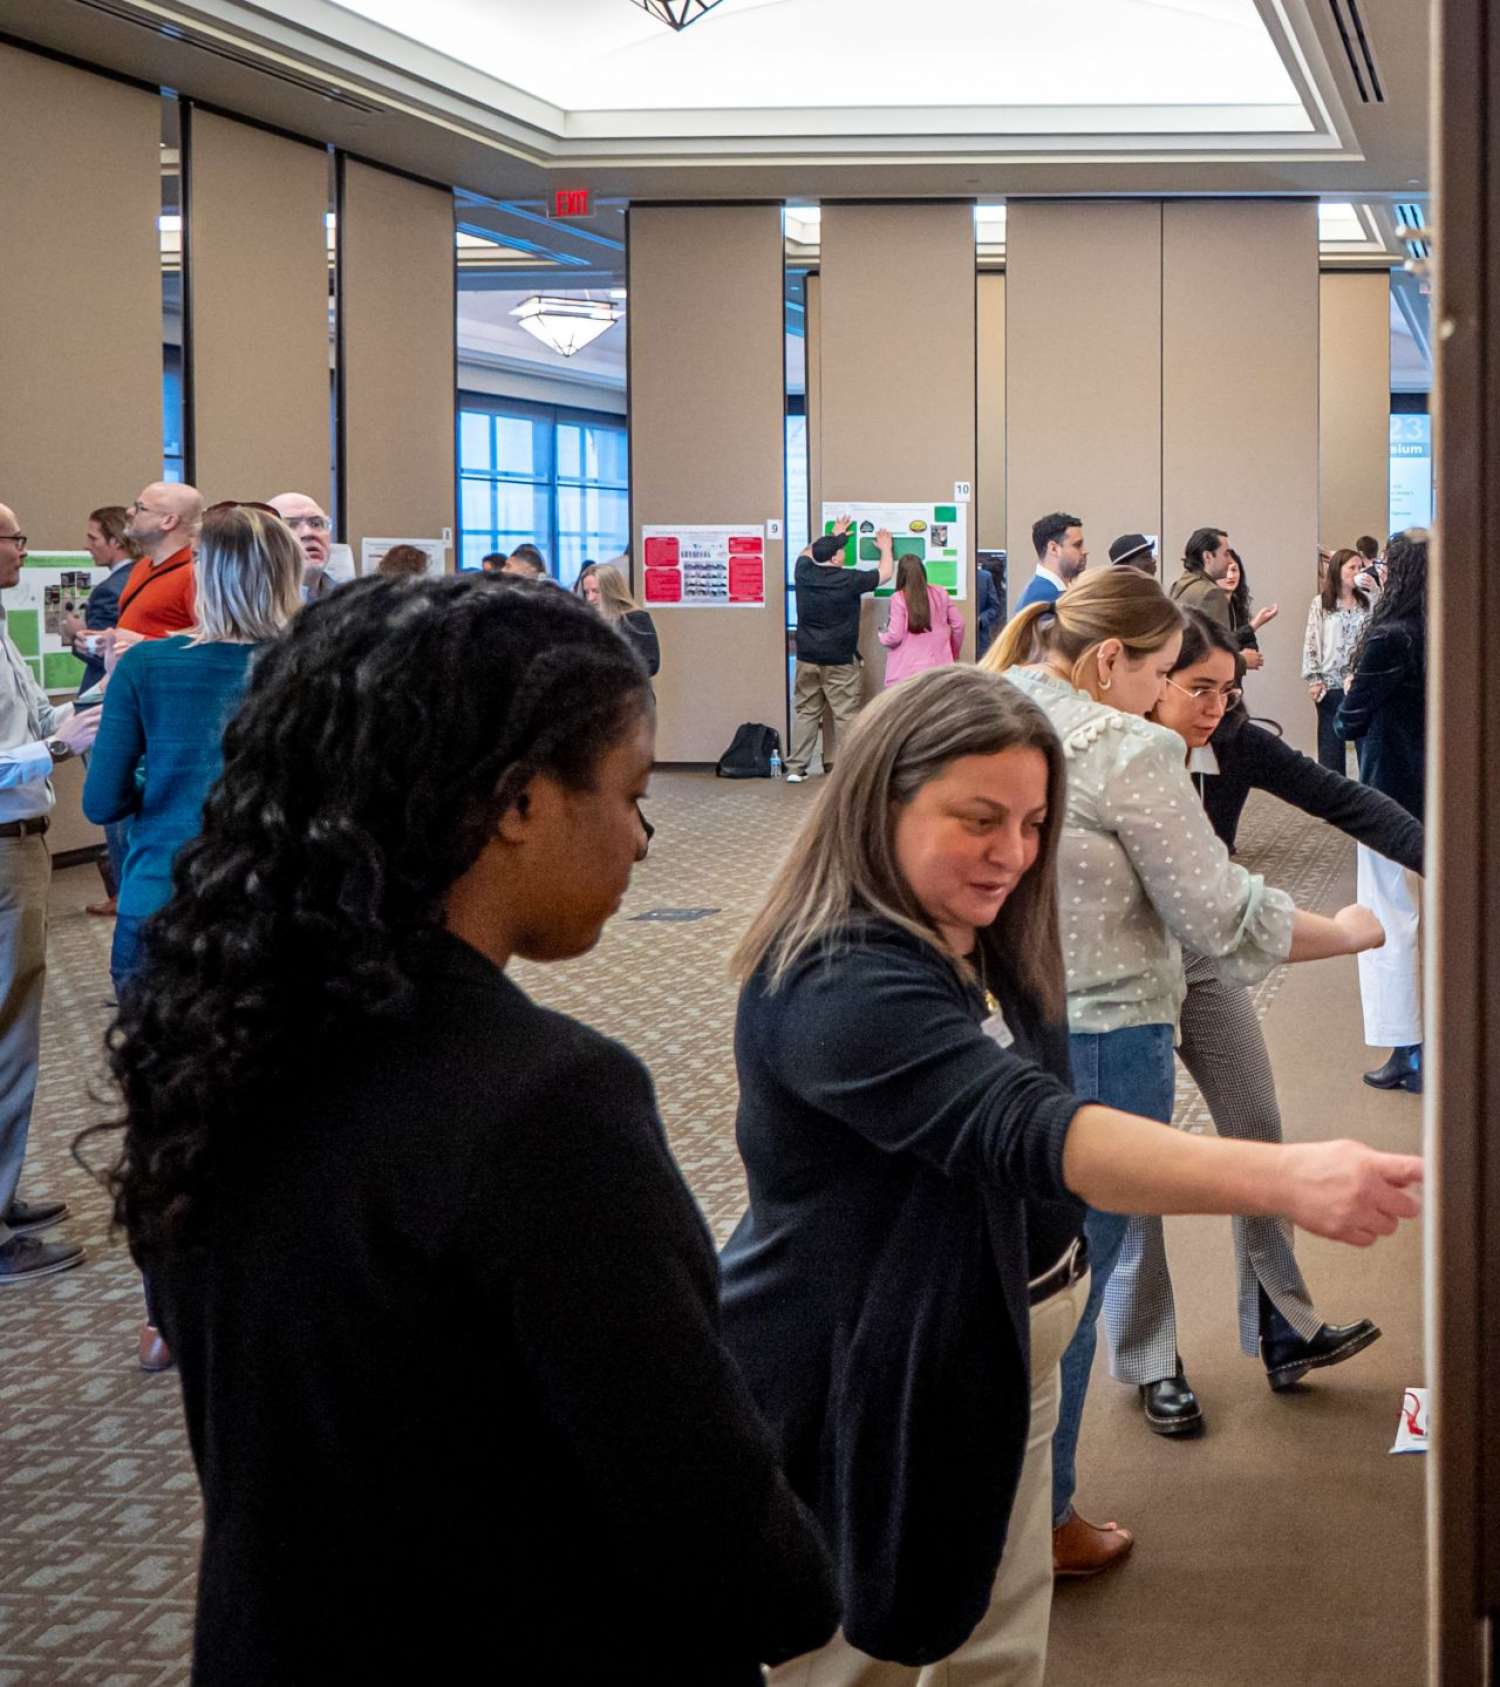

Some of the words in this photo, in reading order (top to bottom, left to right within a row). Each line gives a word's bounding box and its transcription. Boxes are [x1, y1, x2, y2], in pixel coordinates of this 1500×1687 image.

[556, 191, 588, 216] EXIT
[957, 484, 969, 495] 10
[770, 523, 779, 534] 9
